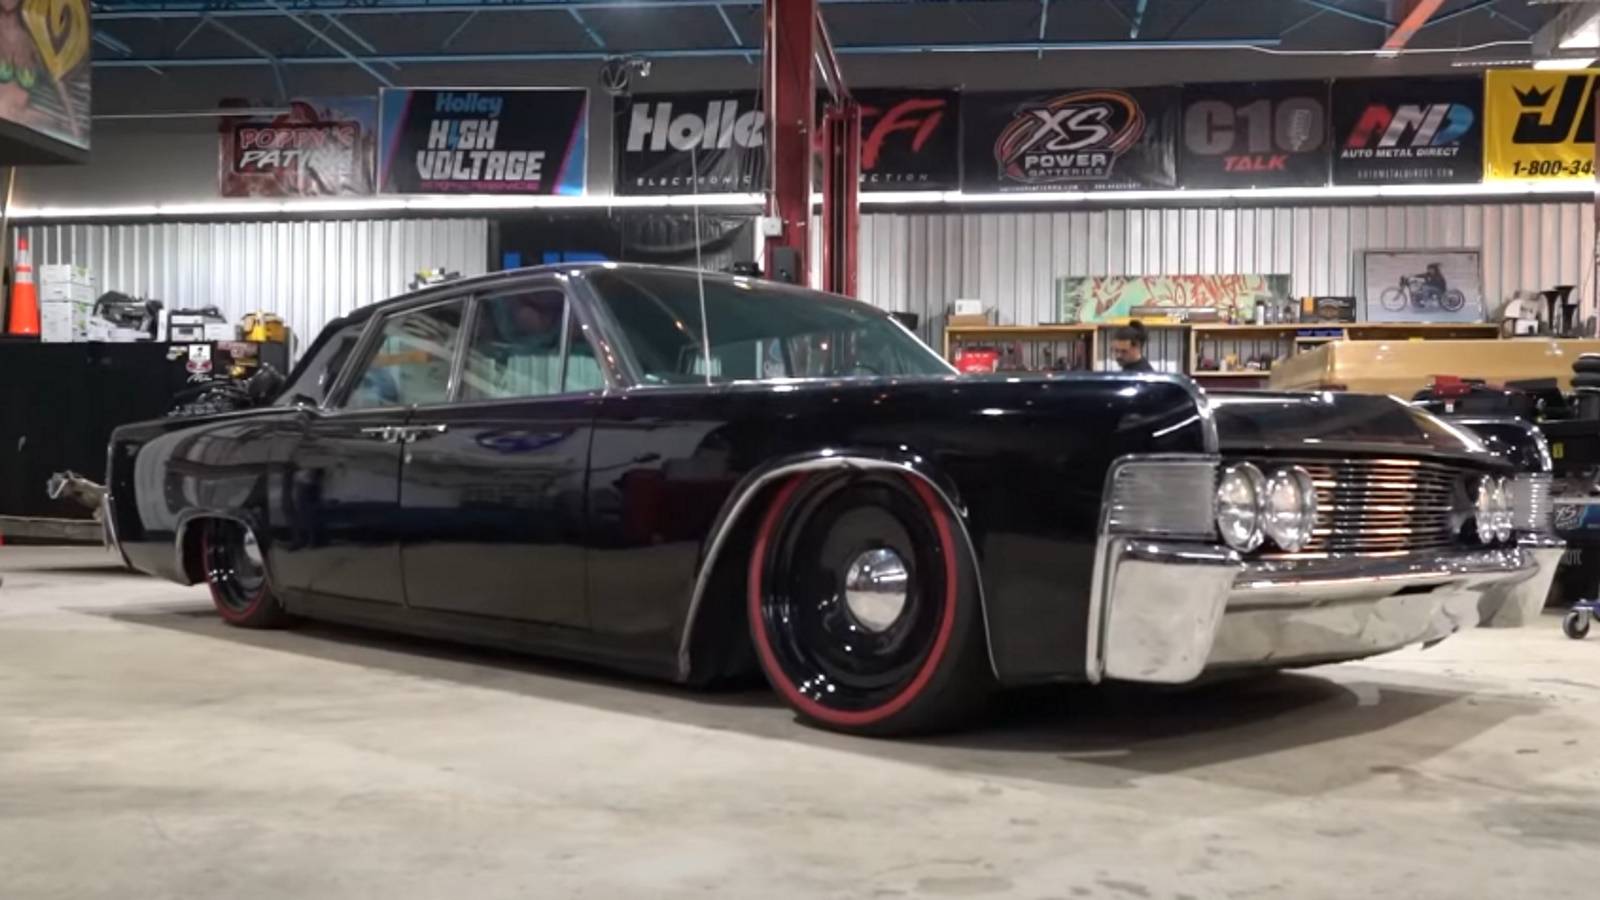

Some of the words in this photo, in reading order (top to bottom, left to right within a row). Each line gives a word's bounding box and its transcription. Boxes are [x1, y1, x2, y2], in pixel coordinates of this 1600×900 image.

[435, 92, 503, 117] Holley
[427, 119, 499, 150] HIGH
[626, 100, 765, 152] Holle
[1016, 107, 1109, 152] XS
[1185, 98, 1324, 155] C10
[1346, 104, 1474, 147] AMD
[239, 128, 355, 149] POPPY'S
[1025, 154, 1106, 169] POWER
[1223, 155, 1290, 171] TALK
[1341, 149, 1373, 158] AUTO
[1376, 148, 1413, 158] METAL
[1416, 147, 1459, 157] DIRECT
[416, 151, 545, 180] VOLTAGE
[859, 173, 928, 182] ECTION
[1028, 167, 1104, 177] BATTERIES
